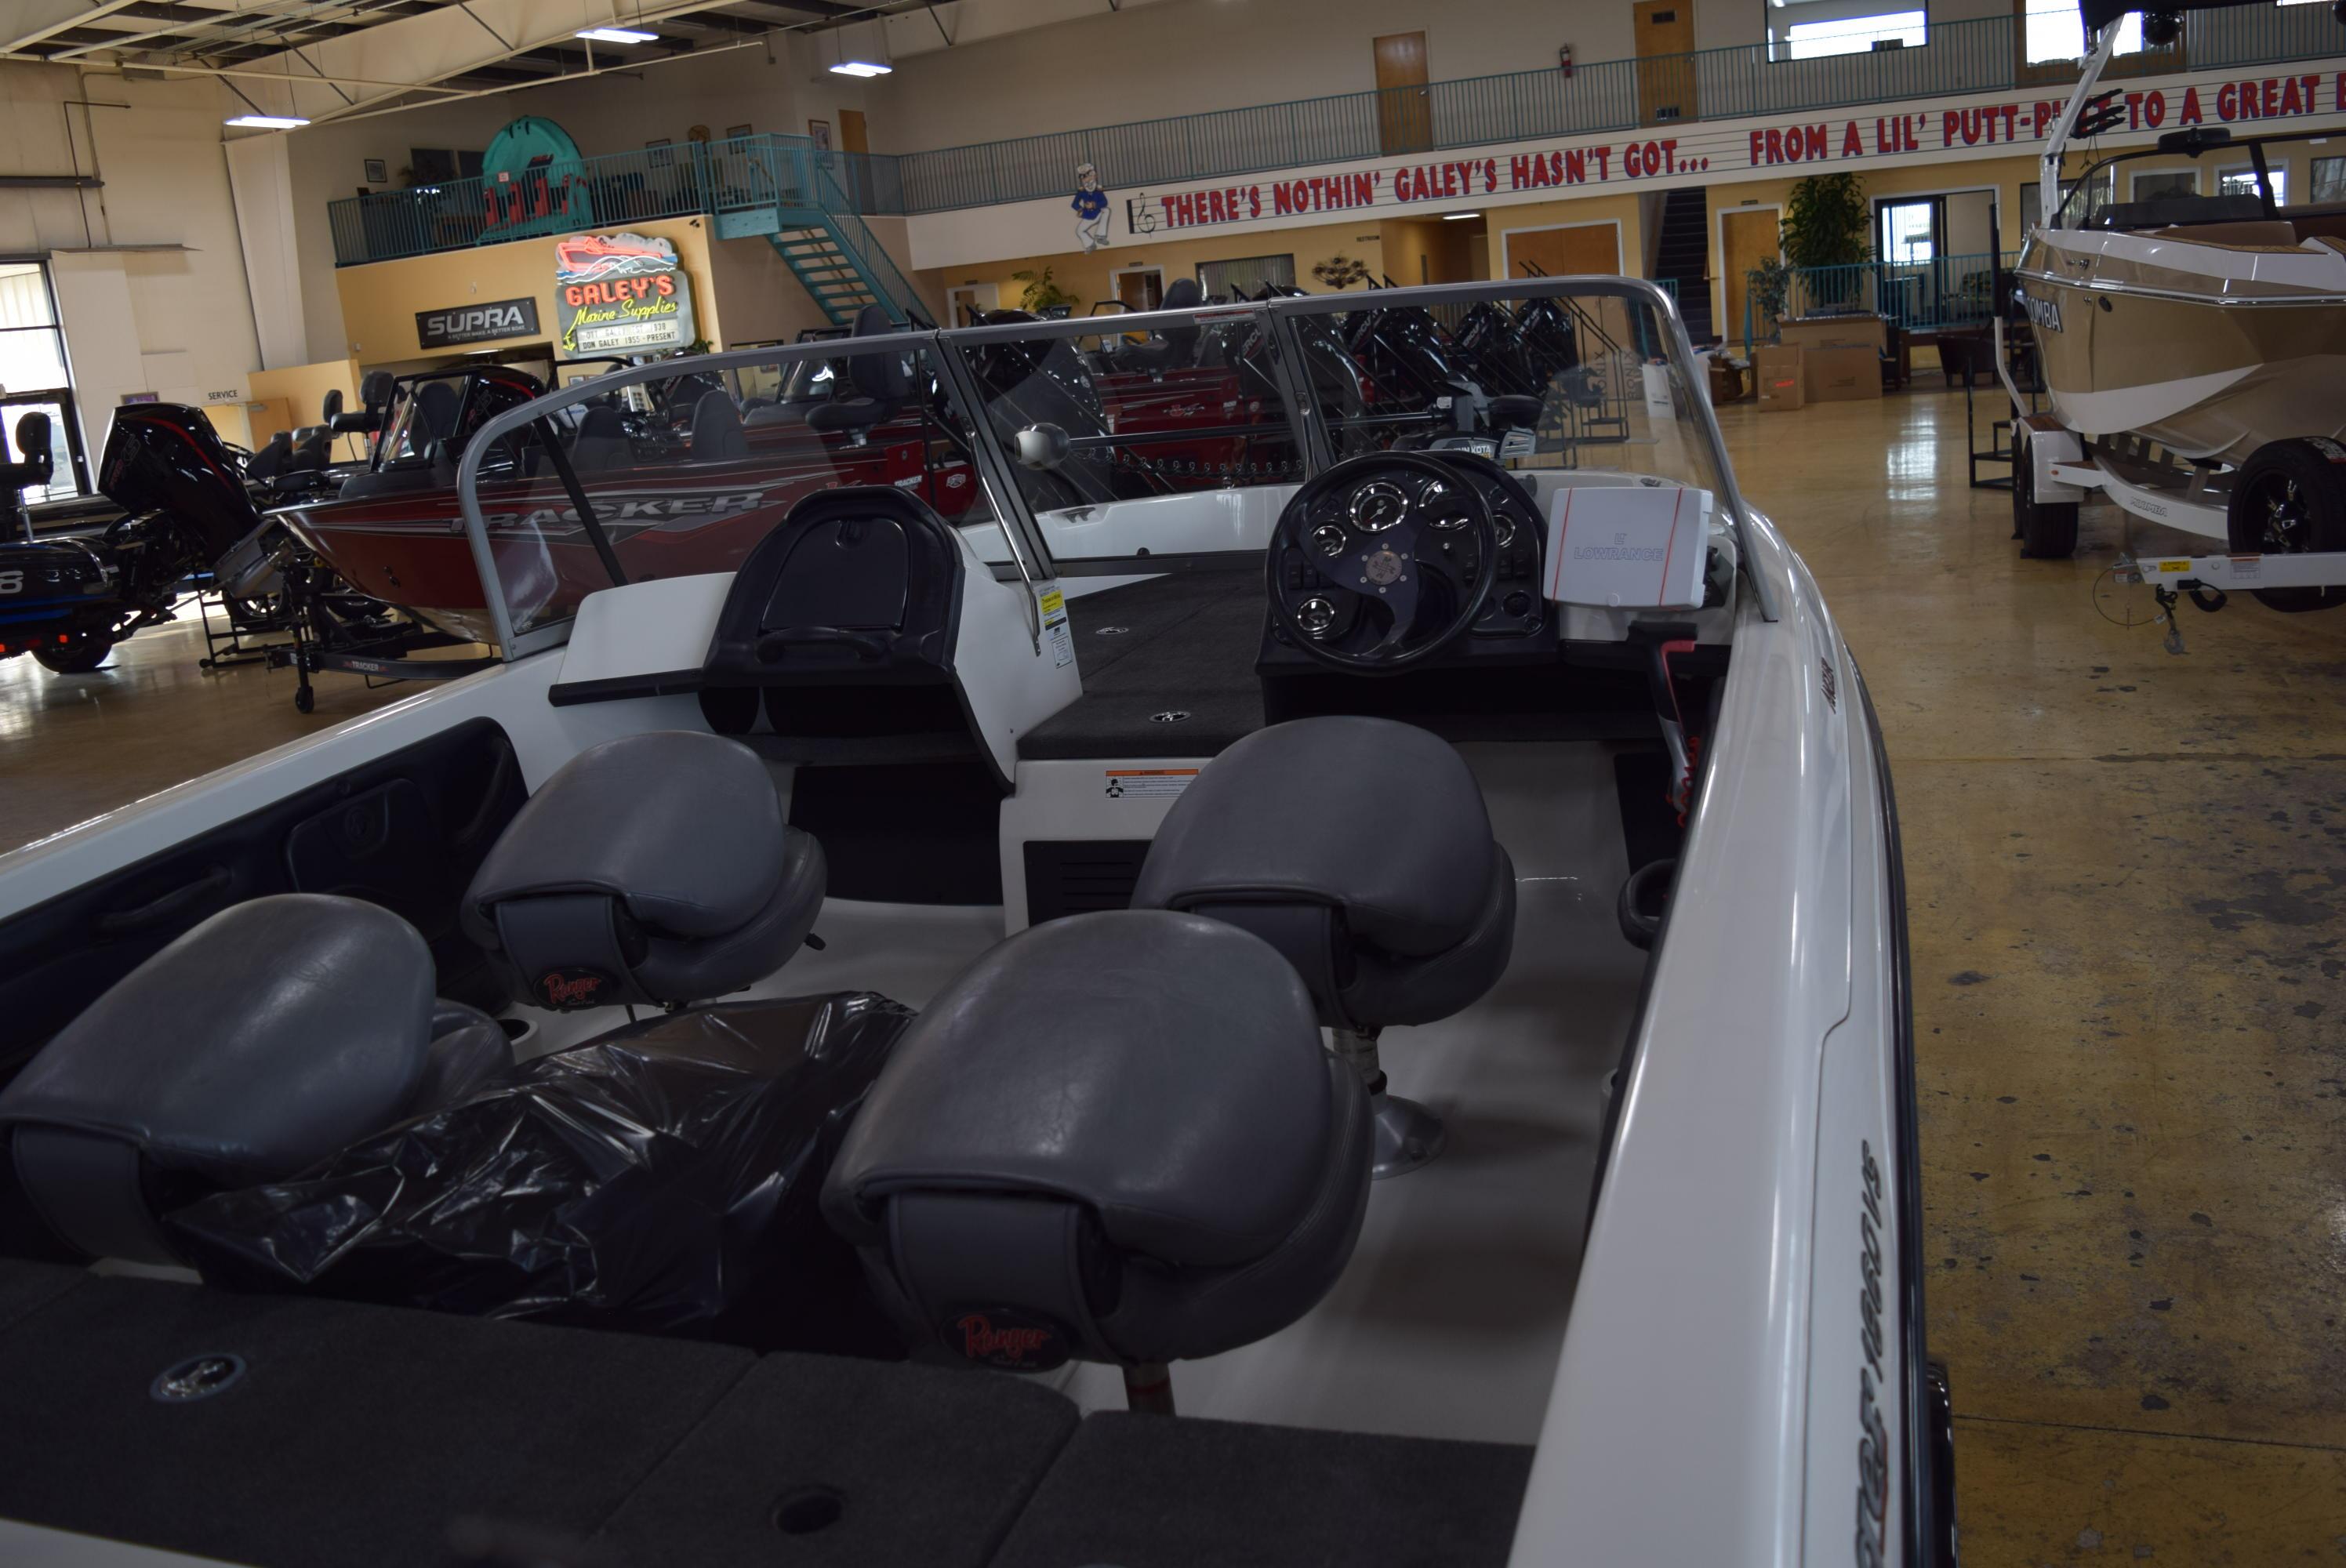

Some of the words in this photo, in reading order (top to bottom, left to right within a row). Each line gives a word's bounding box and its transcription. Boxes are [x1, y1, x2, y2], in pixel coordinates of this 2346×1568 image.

[1750, 124, 1828, 165] FROM
[1843, 121, 1863, 157] A
[1877, 114, 1926, 154] LIL'
[2125, 90, 2166, 130] TO
[2180, 86, 2203, 125] A
[2217, 74, 2321, 121] GREAT
[1161, 185, 1261, 227] THERE'S
[1273, 171, 1380, 215] NOTHIN'
[1394, 158, 1497, 201] GALEY'S
[1510, 146, 1611, 190] HASN'T
[1624, 140, 1709, 178] GOT...
[565, 274, 675, 307] GALEY'S
[427, 306, 524, 336] SUPRA
[577, 306, 616, 325] Marine
[619, 296, 677, 321] Supplies
[583, 341, 596, 350] DON
[208, 390, 238, 401] SERVICE
[1574, 546, 1664, 561] LOWRANCE
[351, 660, 380, 672] TRACKER
[543, 973, 602, 1004] Ranger
[956, 1312, 1053, 1360] Ranger
